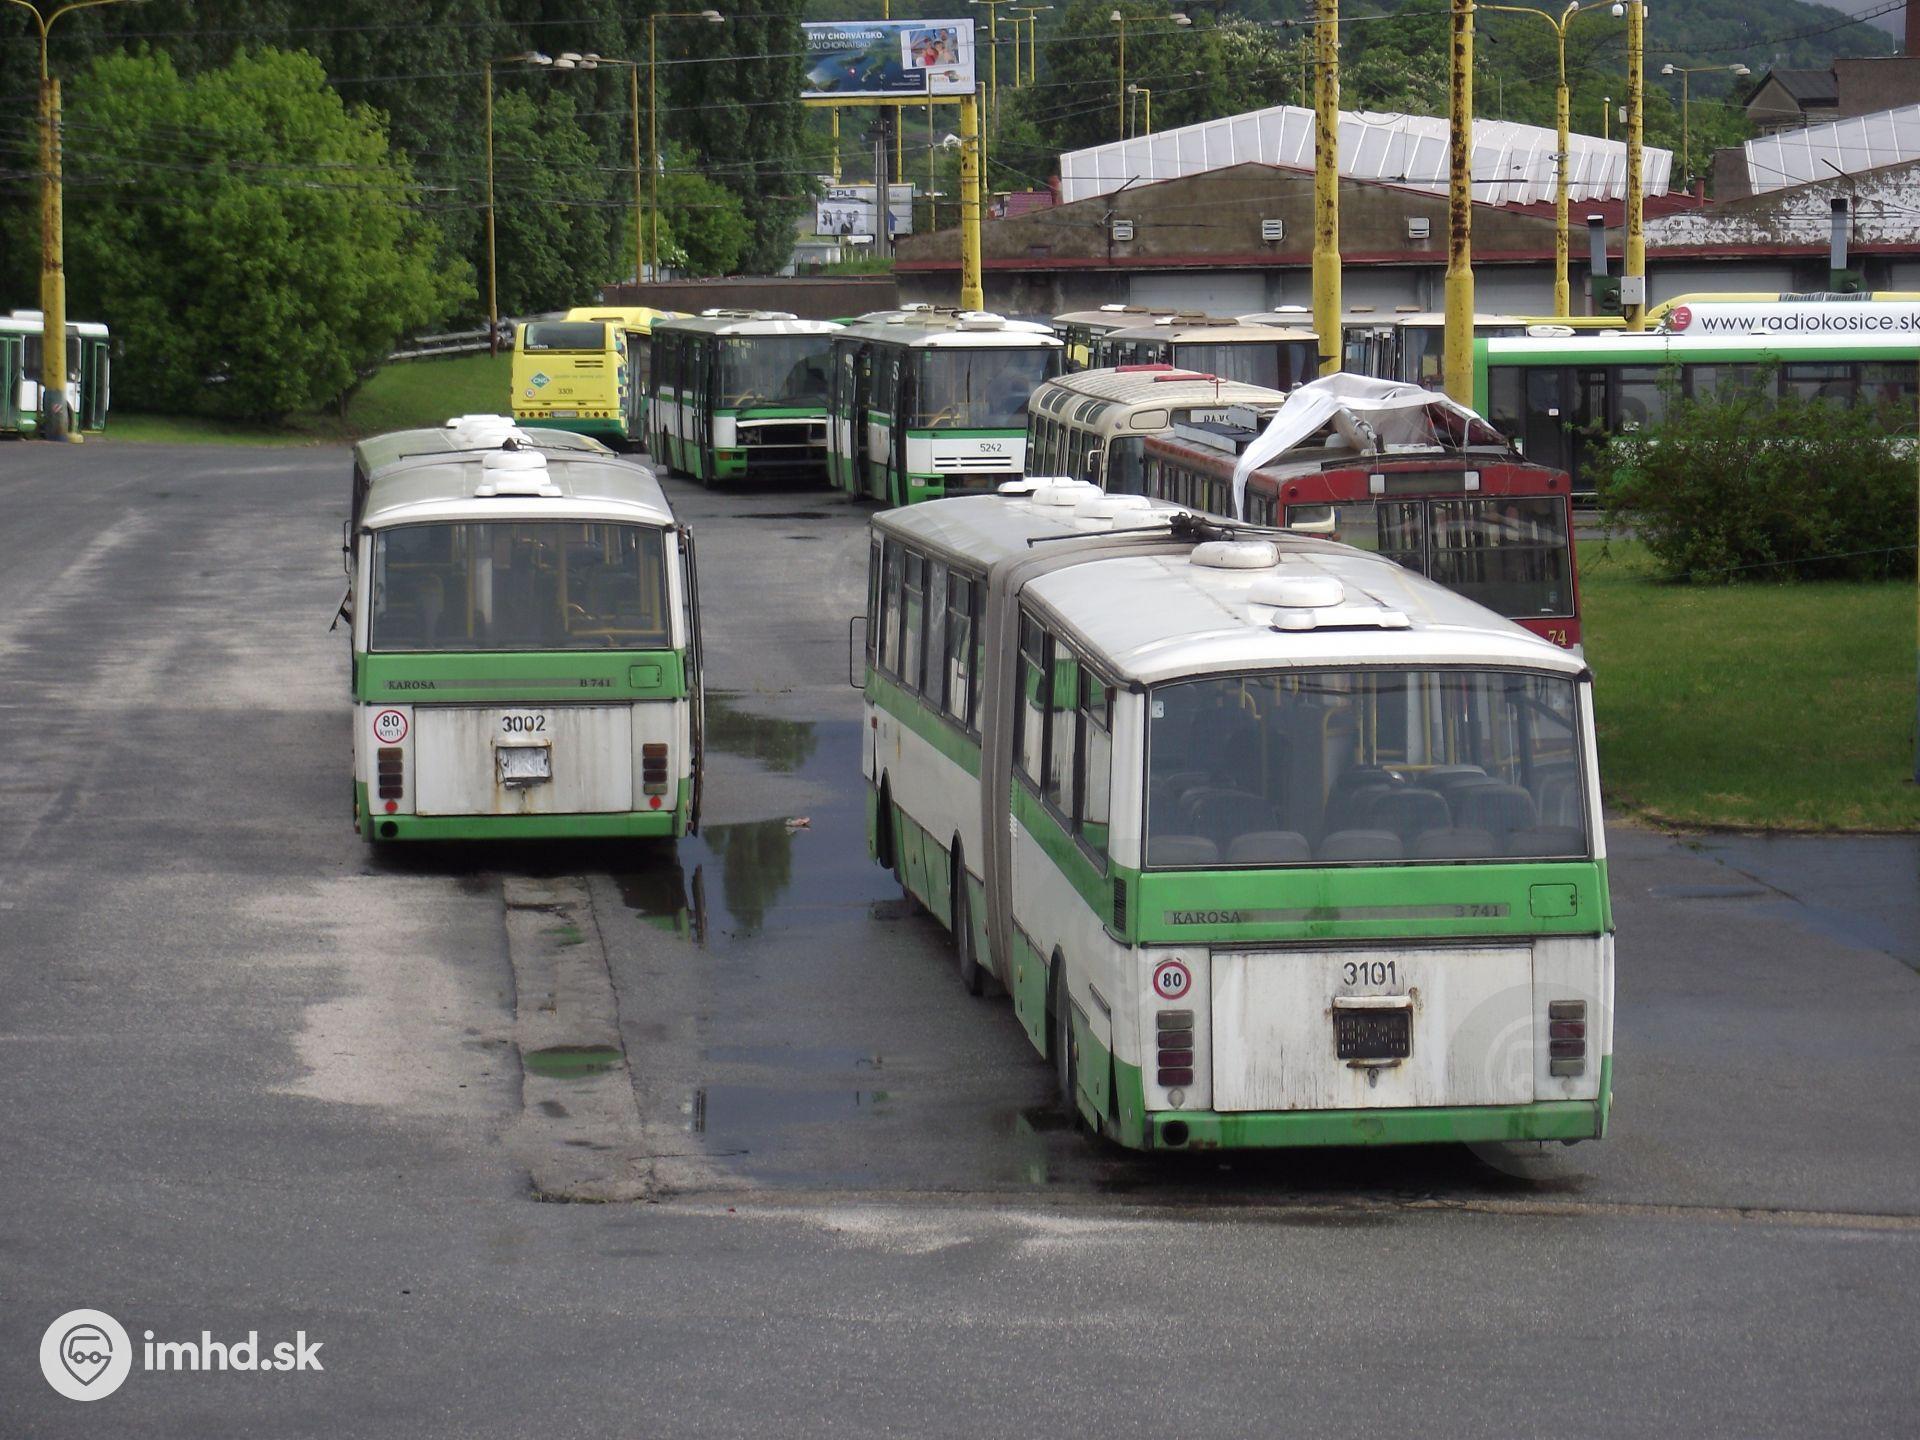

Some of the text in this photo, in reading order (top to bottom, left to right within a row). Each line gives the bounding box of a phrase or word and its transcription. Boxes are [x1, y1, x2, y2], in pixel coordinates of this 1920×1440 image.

[1701, 313, 1920, 330] wwwradiokosice.sk
[980, 443, 1002, 452] 5242
[1548, 630, 1567, 646] 74
[388, 680, 436, 690] KAROSA
[382, 715, 400, 727] 80
[502, 715, 546, 732] 3002
[1172, 911, 1242, 925] KAROSA
[1163, 972, 1182, 988] 80
[1343, 960, 1397, 986] 3101
